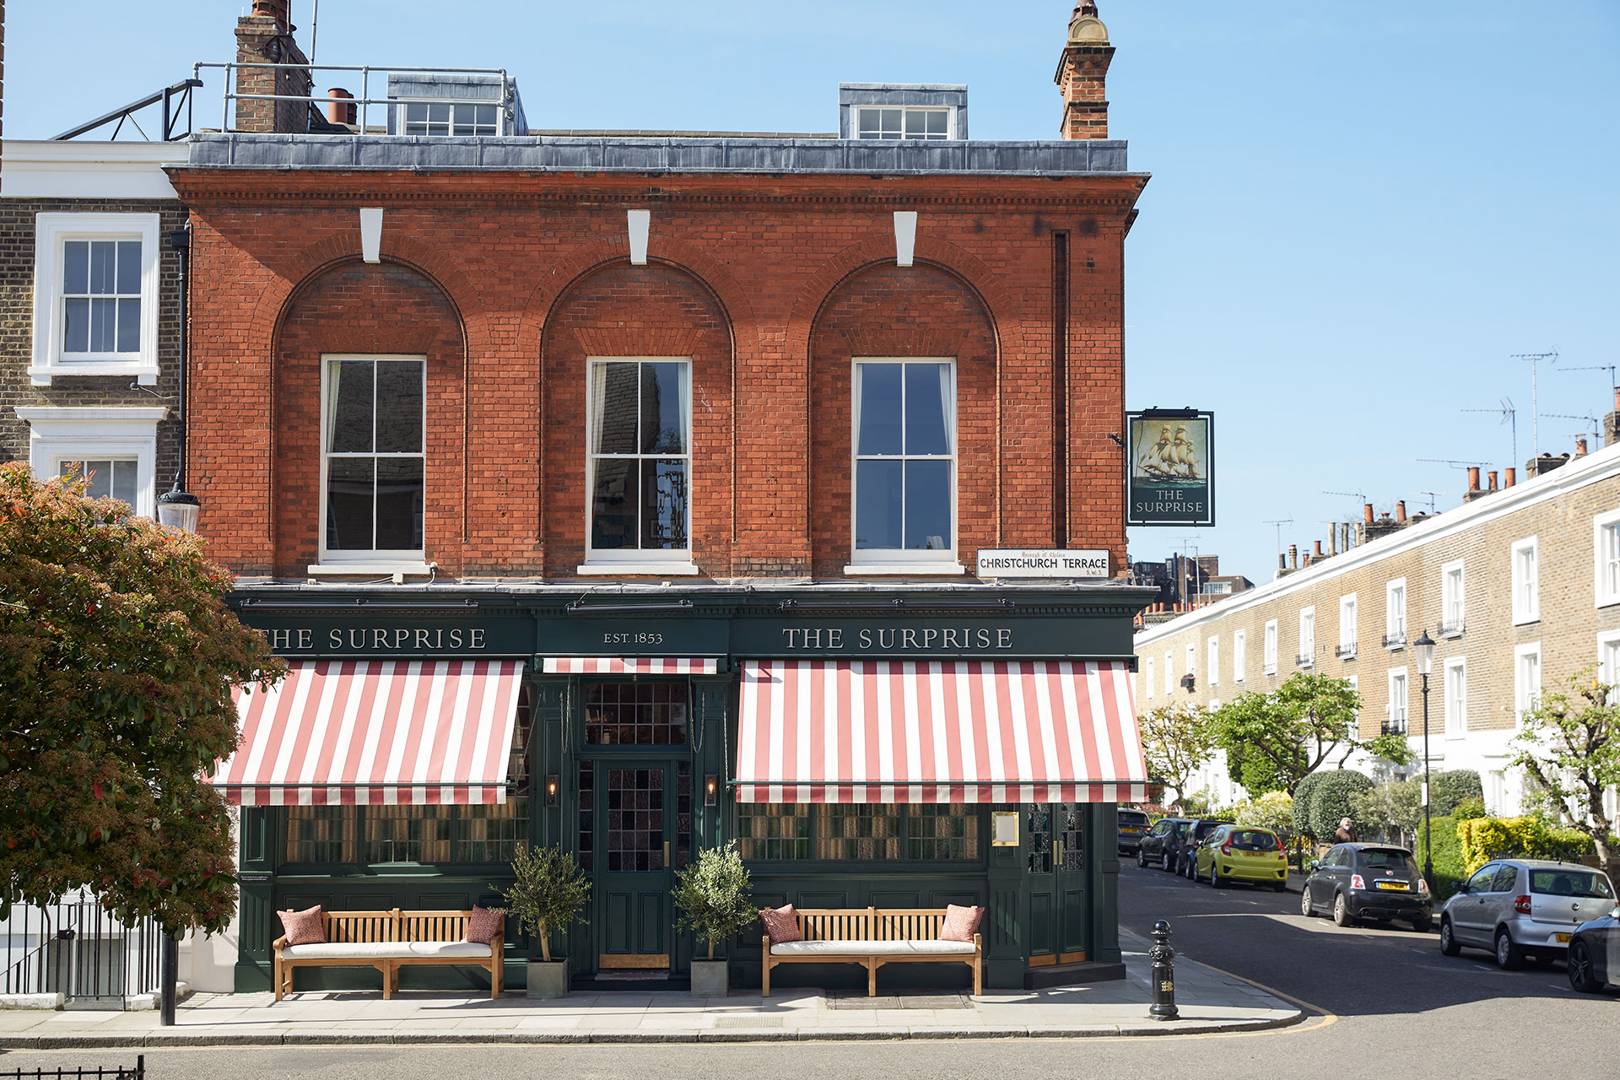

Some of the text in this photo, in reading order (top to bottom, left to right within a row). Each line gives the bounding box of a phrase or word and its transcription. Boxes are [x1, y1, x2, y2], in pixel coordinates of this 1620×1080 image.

[1156, 490, 1183, 500] THE
[1136, 502, 1203, 513] SURPRISE
[980, 558, 1107, 569] CHRISTCHURCH TERRACE
[329, 628, 486, 649] SURPRISE
[604, 632, 663, 645] EST. 1853
[782, 628, 1013, 649] THE SURPRISE
